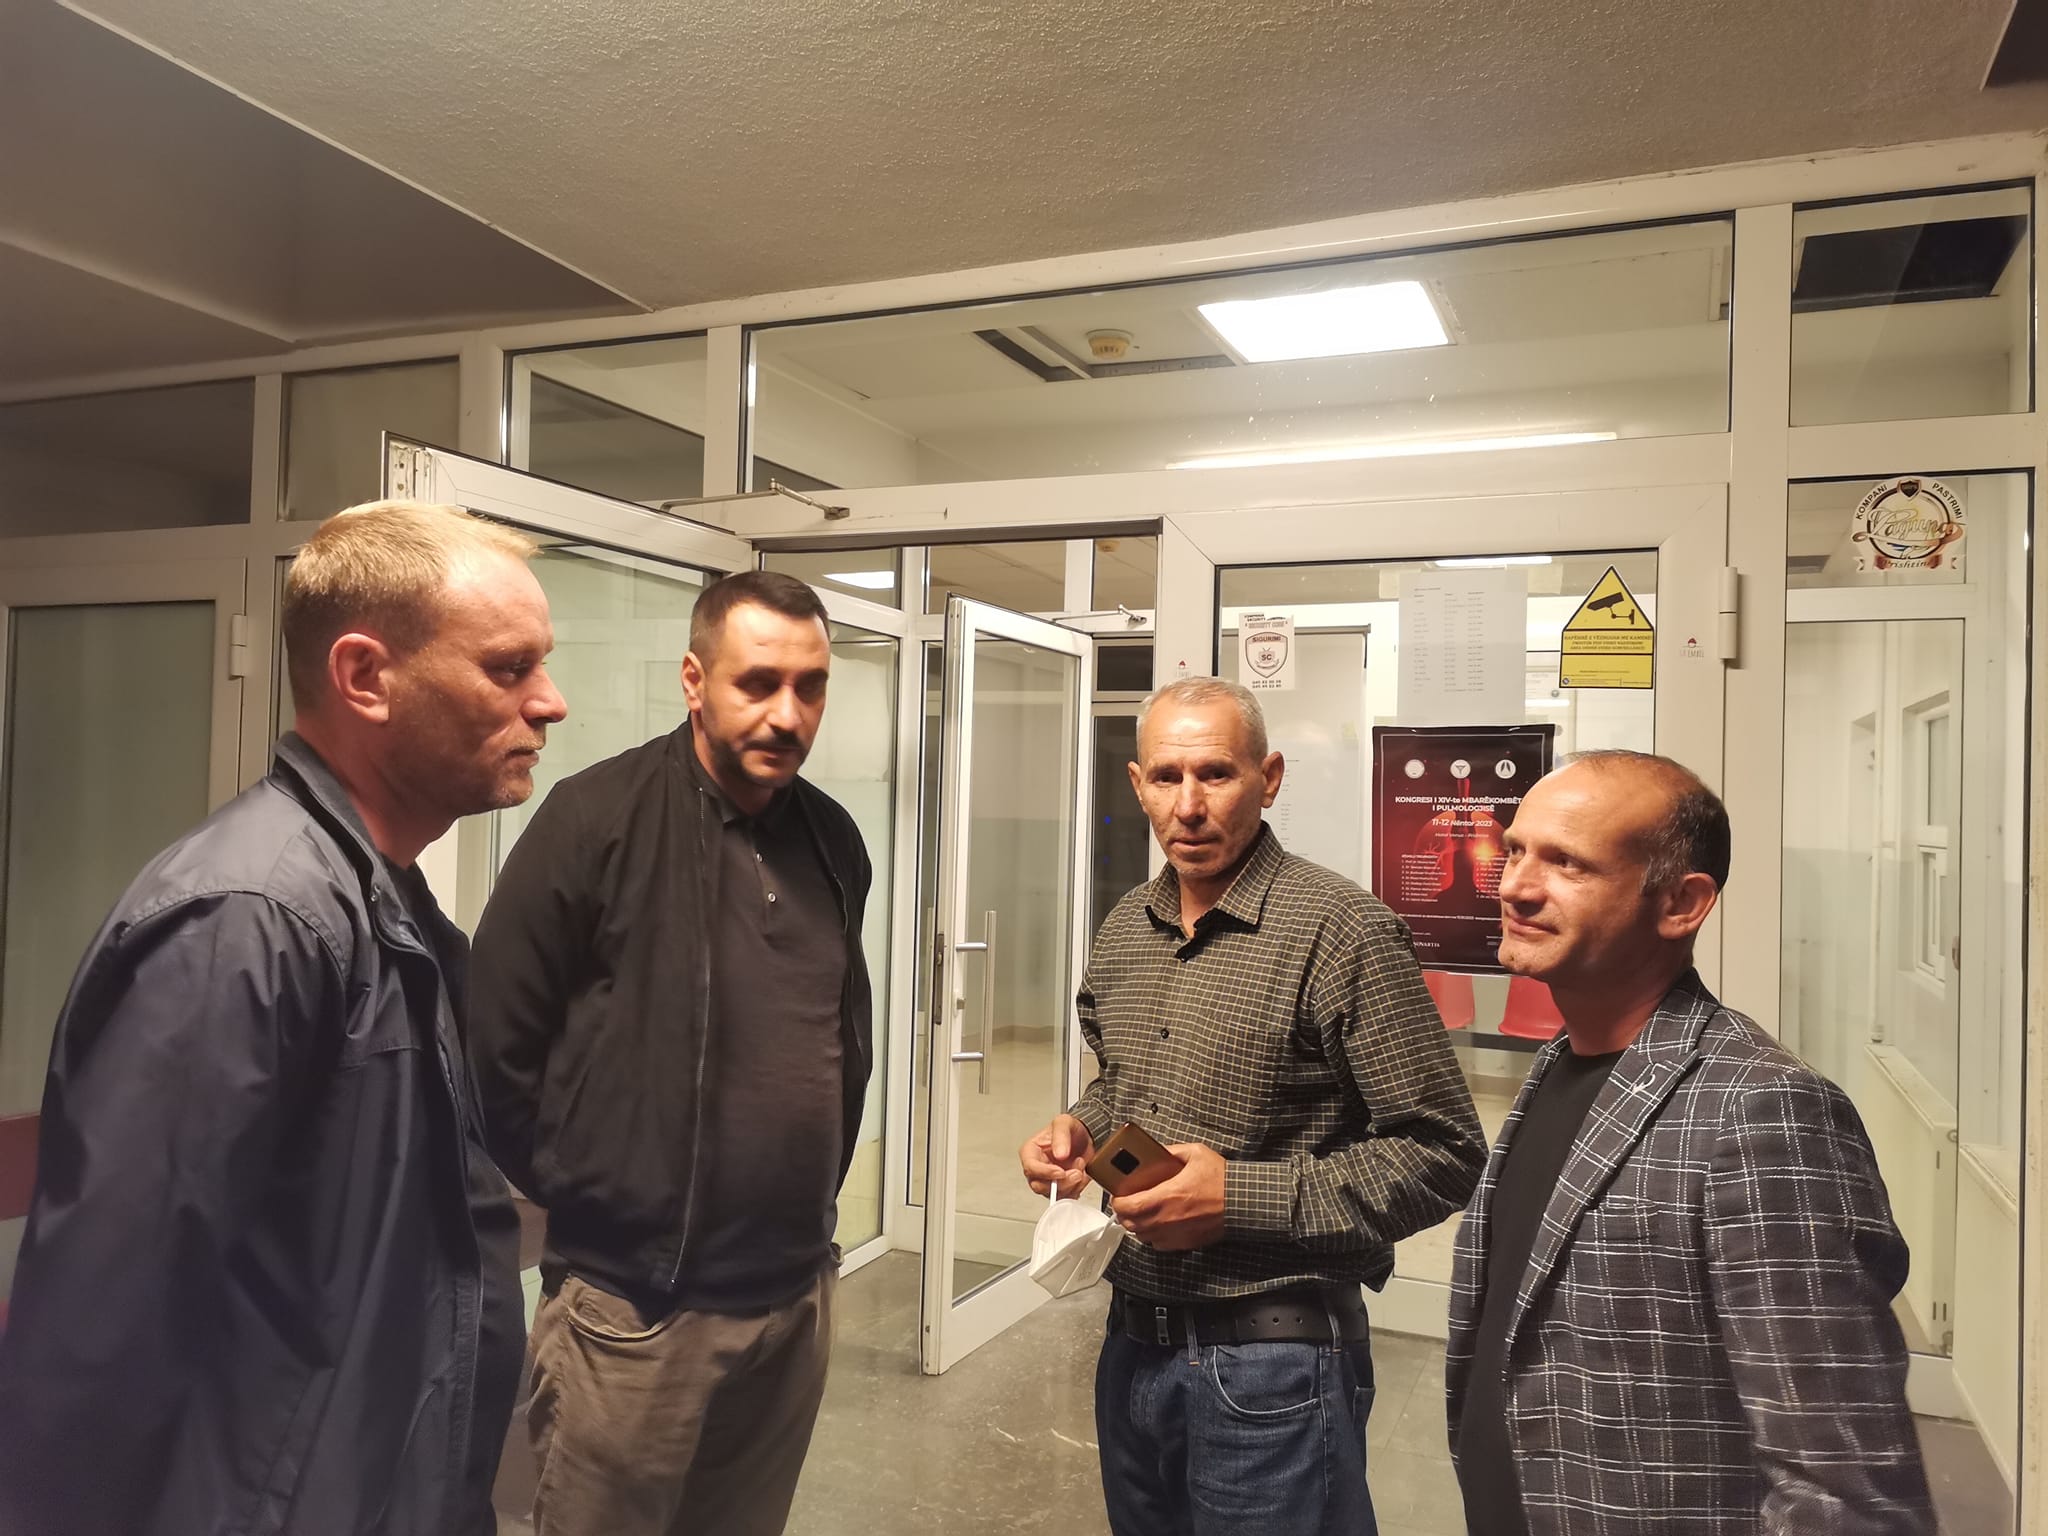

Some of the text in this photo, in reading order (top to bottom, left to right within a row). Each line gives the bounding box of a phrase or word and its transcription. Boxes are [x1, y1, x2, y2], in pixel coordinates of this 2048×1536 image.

[1856, 482, 1963, 520] KOMPANI PASTRIMI
[1462, 796, 1522, 804] MBARËKOMBËT
[1437, 804, 1495, 812] PULMOLOGJISË
